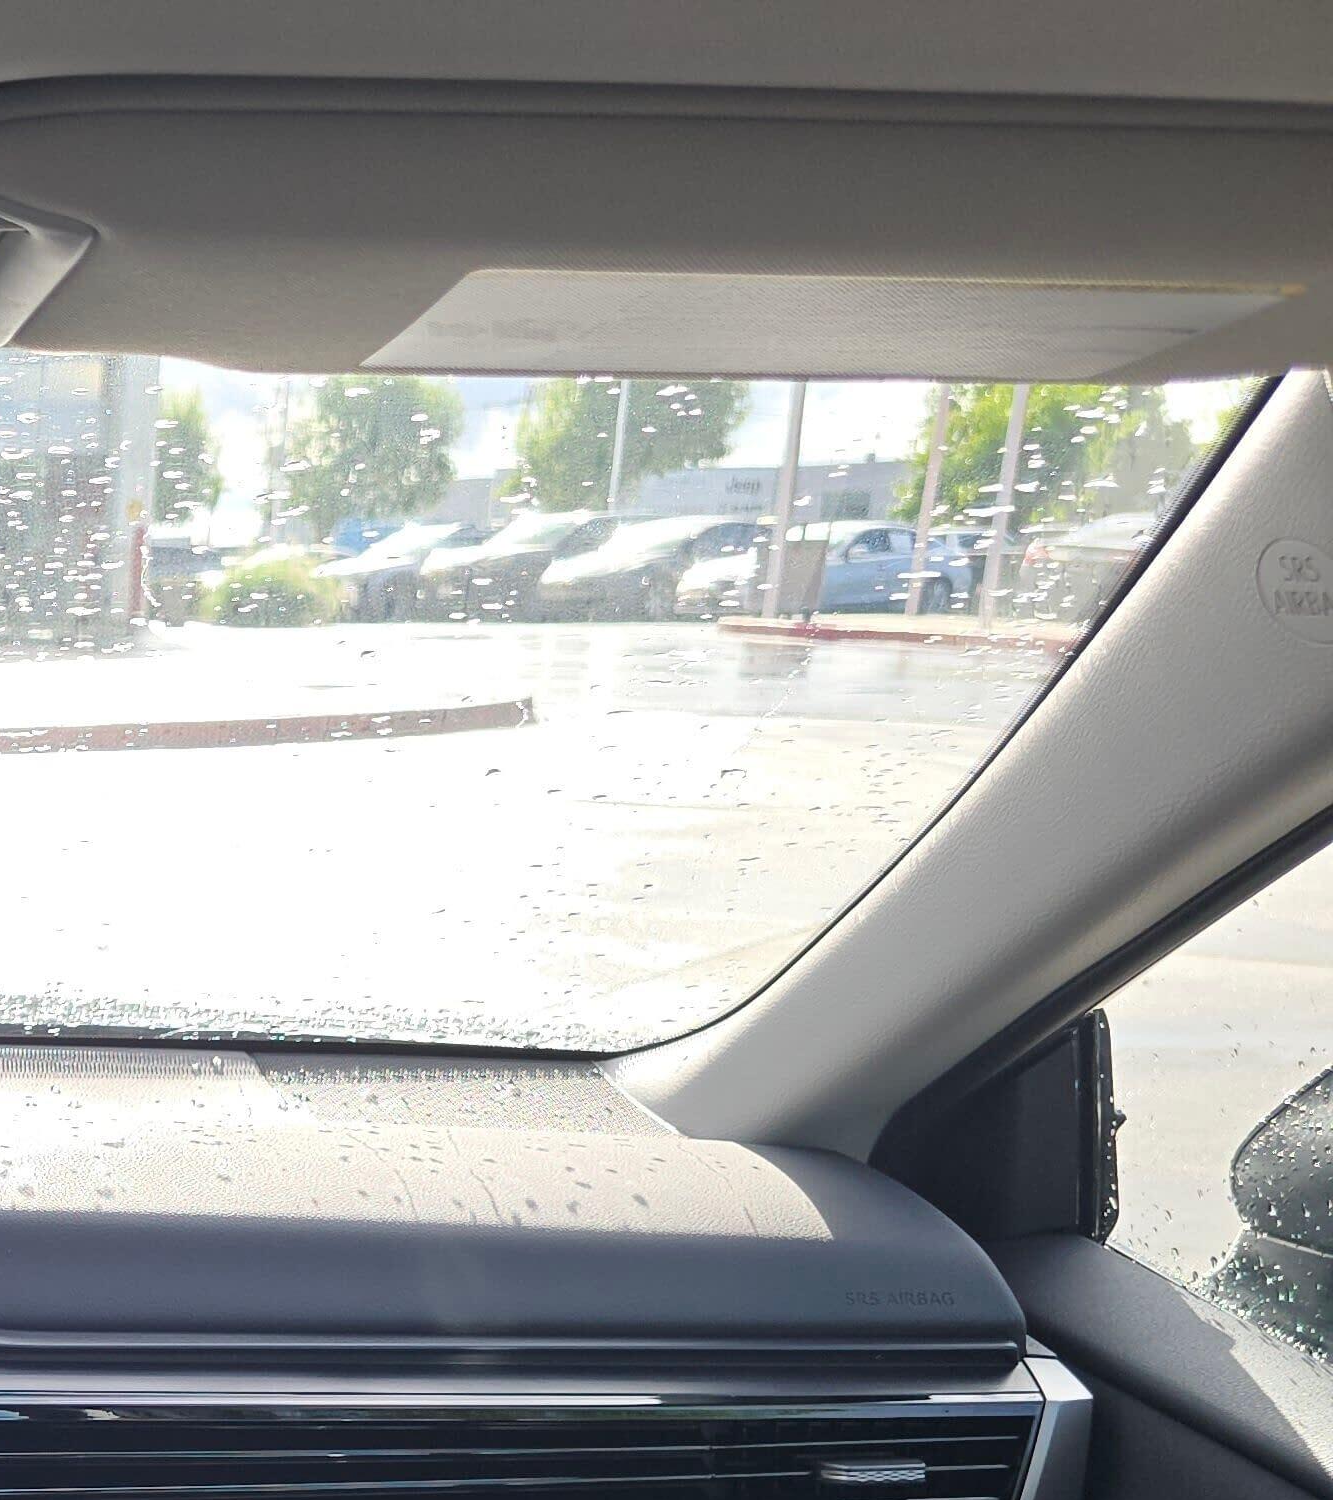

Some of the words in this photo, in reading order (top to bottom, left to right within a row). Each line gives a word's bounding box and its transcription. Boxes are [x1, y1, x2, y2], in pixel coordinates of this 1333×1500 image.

[1278, 555, 1321, 582] SRS
[1273, 590, 1333, 616] AIRBA
[886, 1291, 955, 1306] AIRBAG
